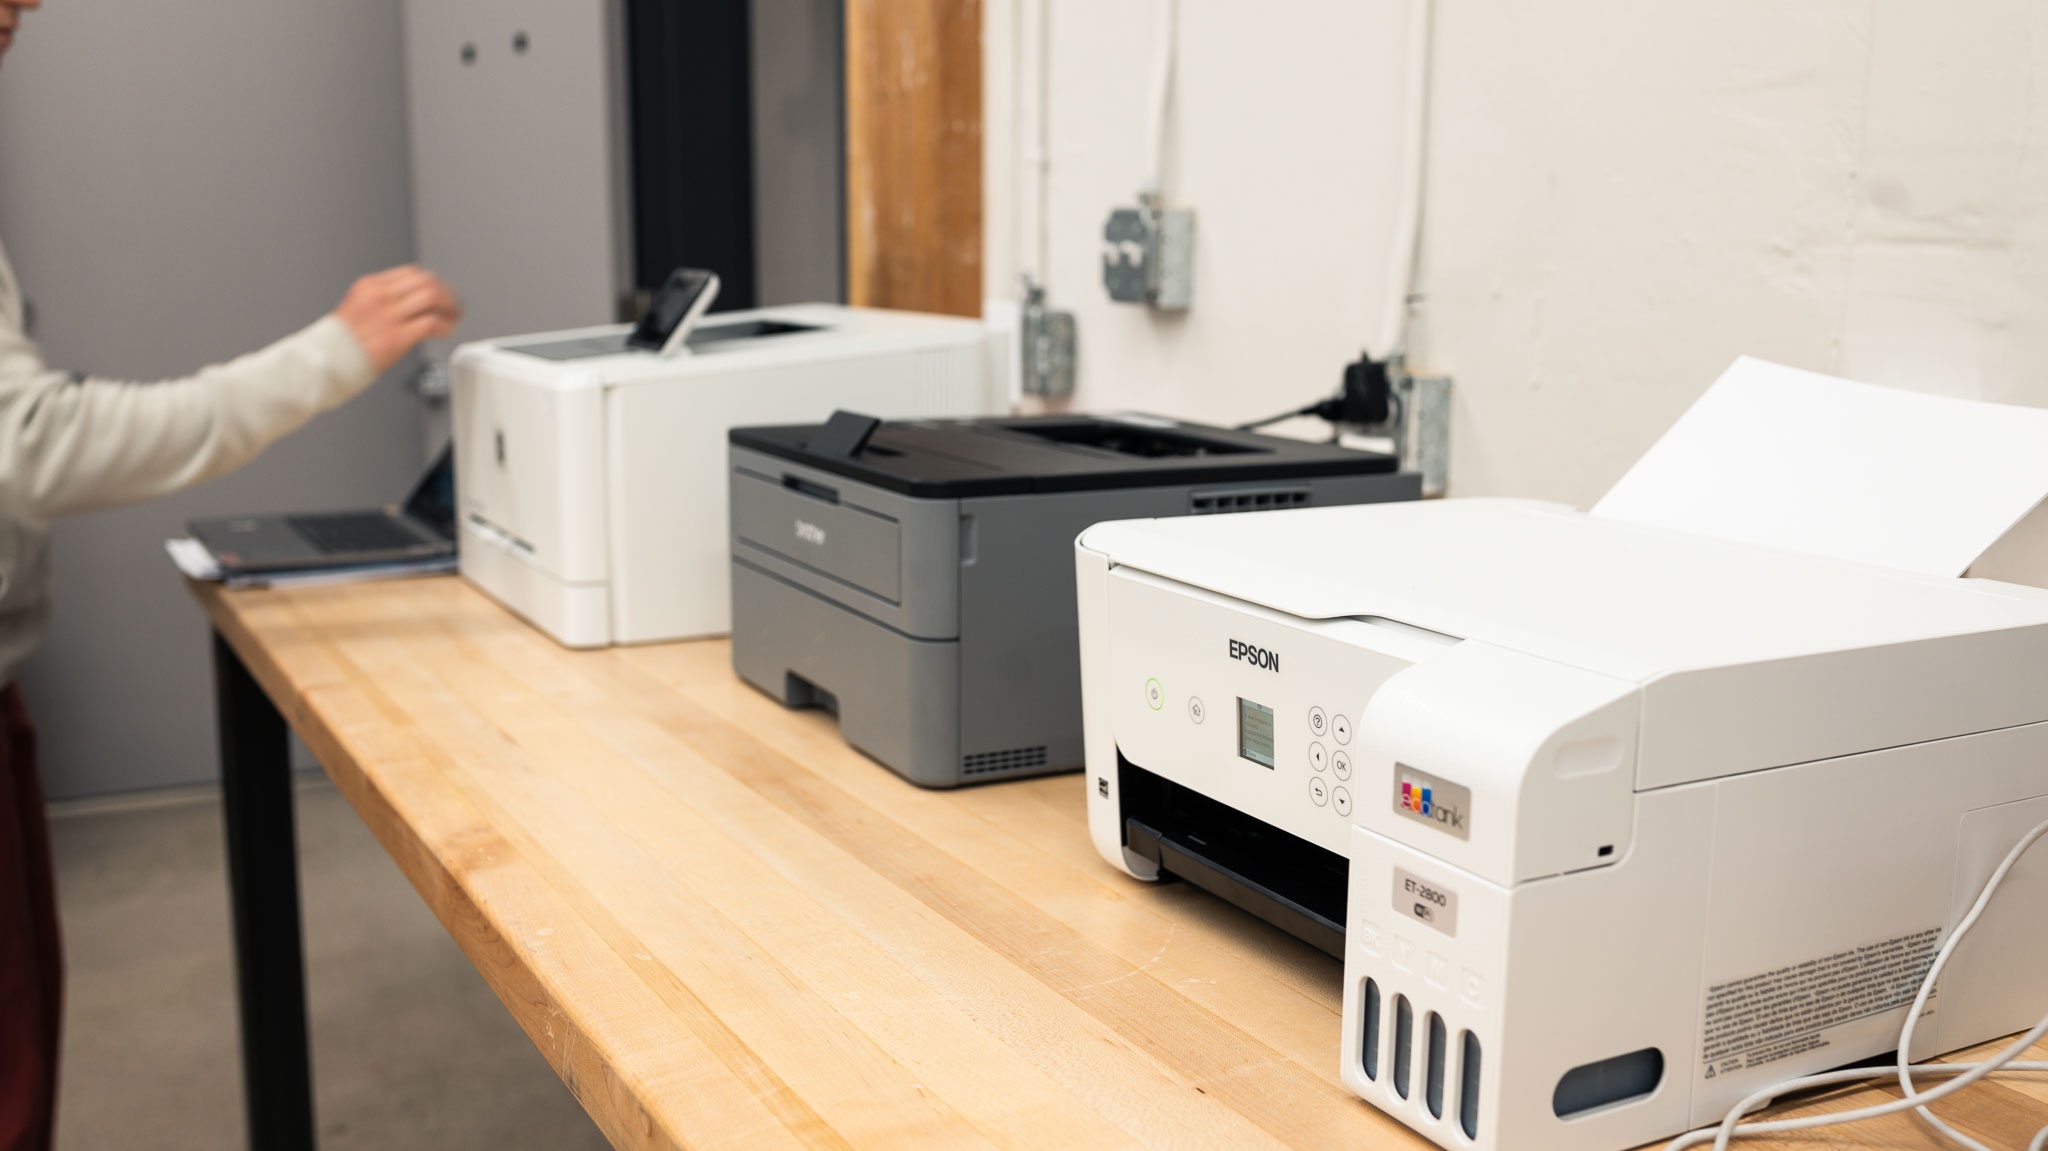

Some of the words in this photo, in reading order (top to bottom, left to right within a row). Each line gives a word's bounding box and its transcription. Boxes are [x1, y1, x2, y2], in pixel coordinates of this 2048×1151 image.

[1229, 638, 1279, 673] EPSON
[1336, 760, 1347, 772] OK
[1404, 878, 1447, 907] ET-2800
